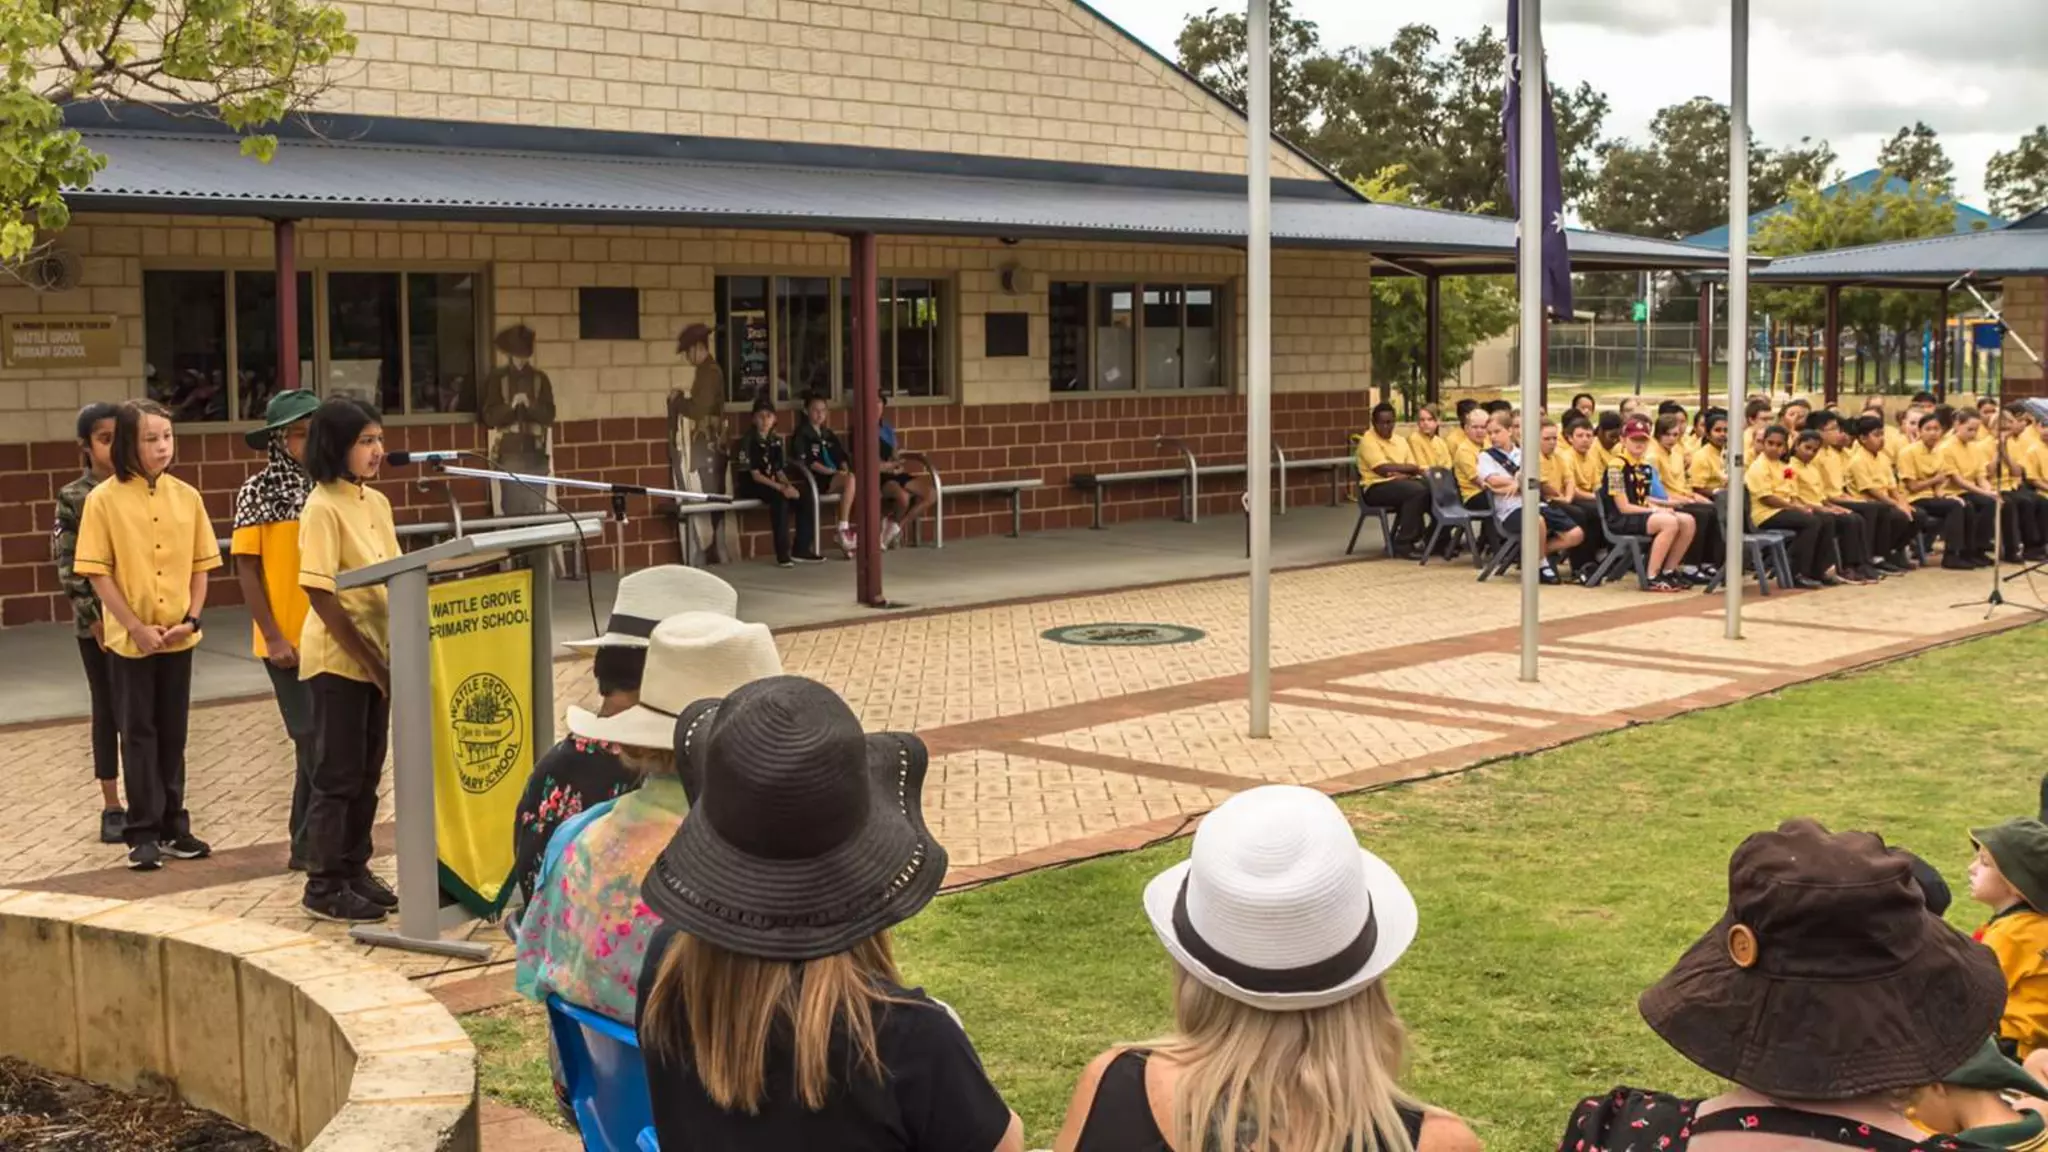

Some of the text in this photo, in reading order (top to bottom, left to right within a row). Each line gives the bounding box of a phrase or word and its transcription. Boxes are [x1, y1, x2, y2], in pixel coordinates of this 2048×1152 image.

[432, 589, 522, 618] WATTLE GROVE
[428, 609, 530, 641] PRIMARY SCHOOL
[451, 676, 513, 718] WATTLE GROVE
